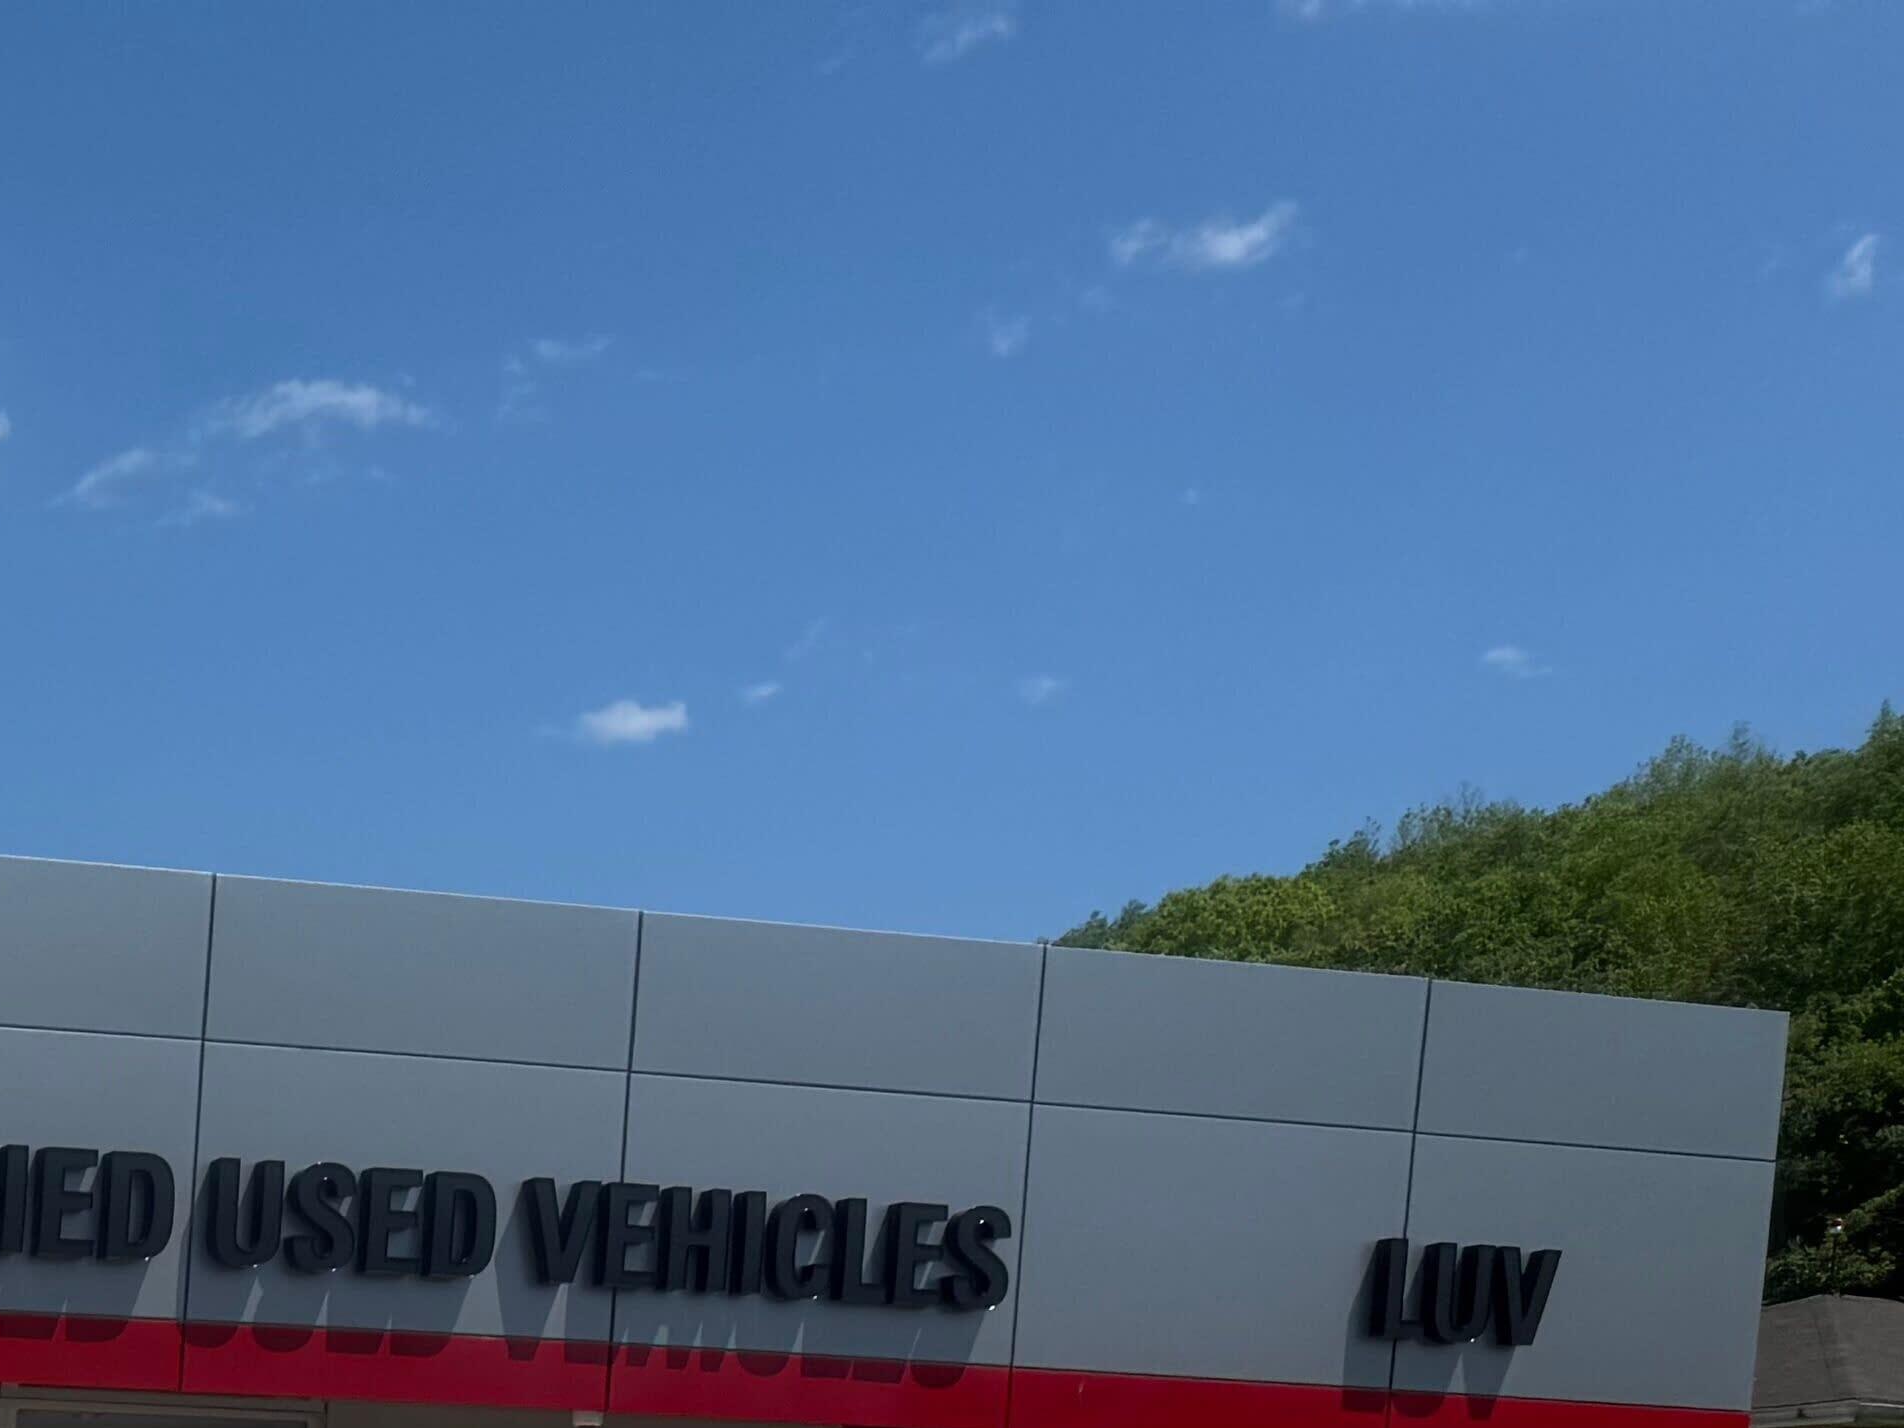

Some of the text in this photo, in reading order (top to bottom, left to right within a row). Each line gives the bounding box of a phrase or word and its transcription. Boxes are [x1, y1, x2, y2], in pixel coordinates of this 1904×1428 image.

[206, 1157, 497, 1279] USED
[520, 1177, 1013, 1311] VEHICLES
[1369, 1237, 1563, 1346] LUV
